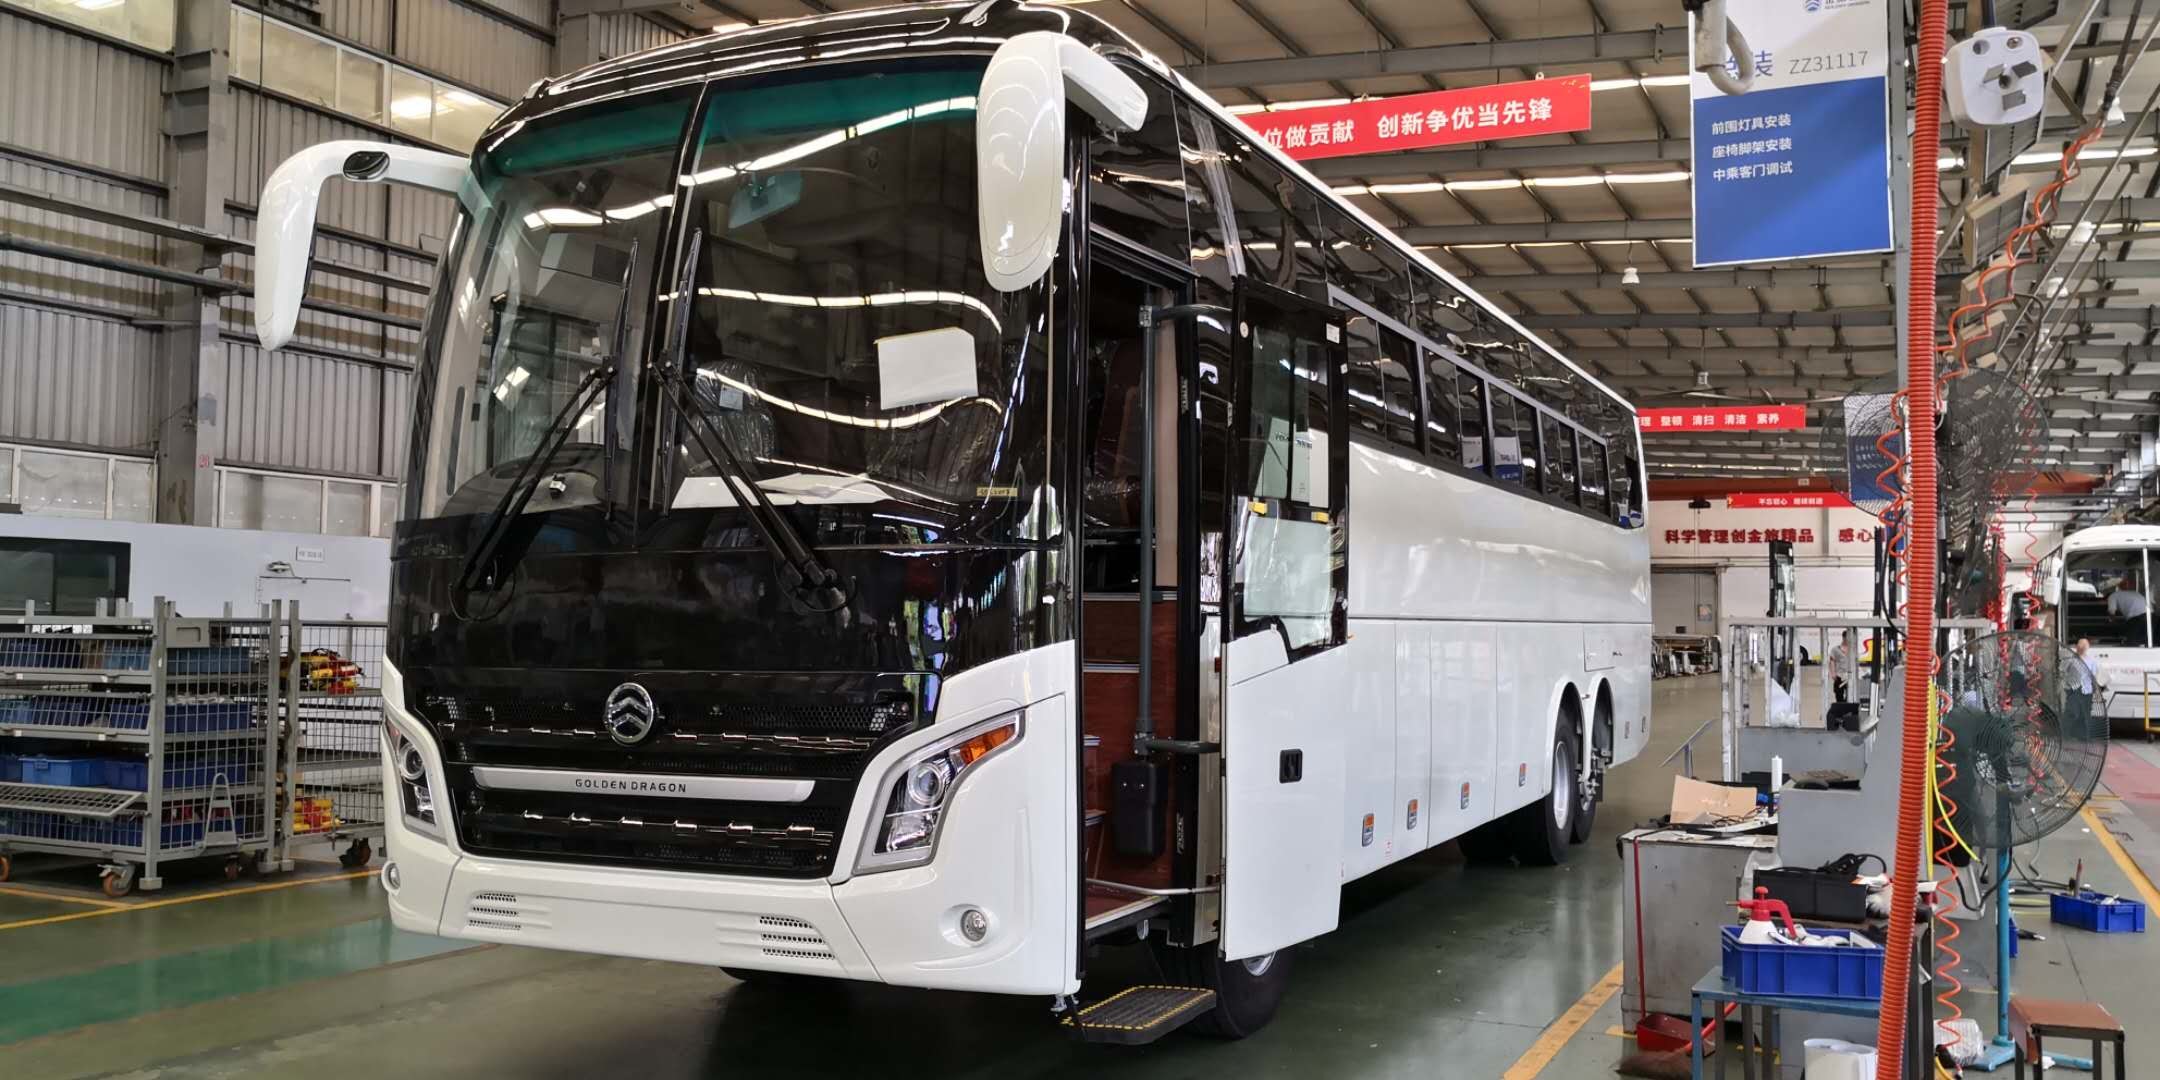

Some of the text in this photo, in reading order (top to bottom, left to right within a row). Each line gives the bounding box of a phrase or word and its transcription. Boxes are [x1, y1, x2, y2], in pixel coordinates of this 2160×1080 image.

[1789, 51, 1868, 75] ZZ31117
[1376, 97, 1553, 138] 创新争优当先锋
[1711, 113, 1792, 136] 前围灯具安装
[1712, 137, 1793, 159] 座椅脚架安装
[1713, 160, 1793, 181] 中乘客门调试
[575, 779, 686, 793] GOLDEN DRAGON
